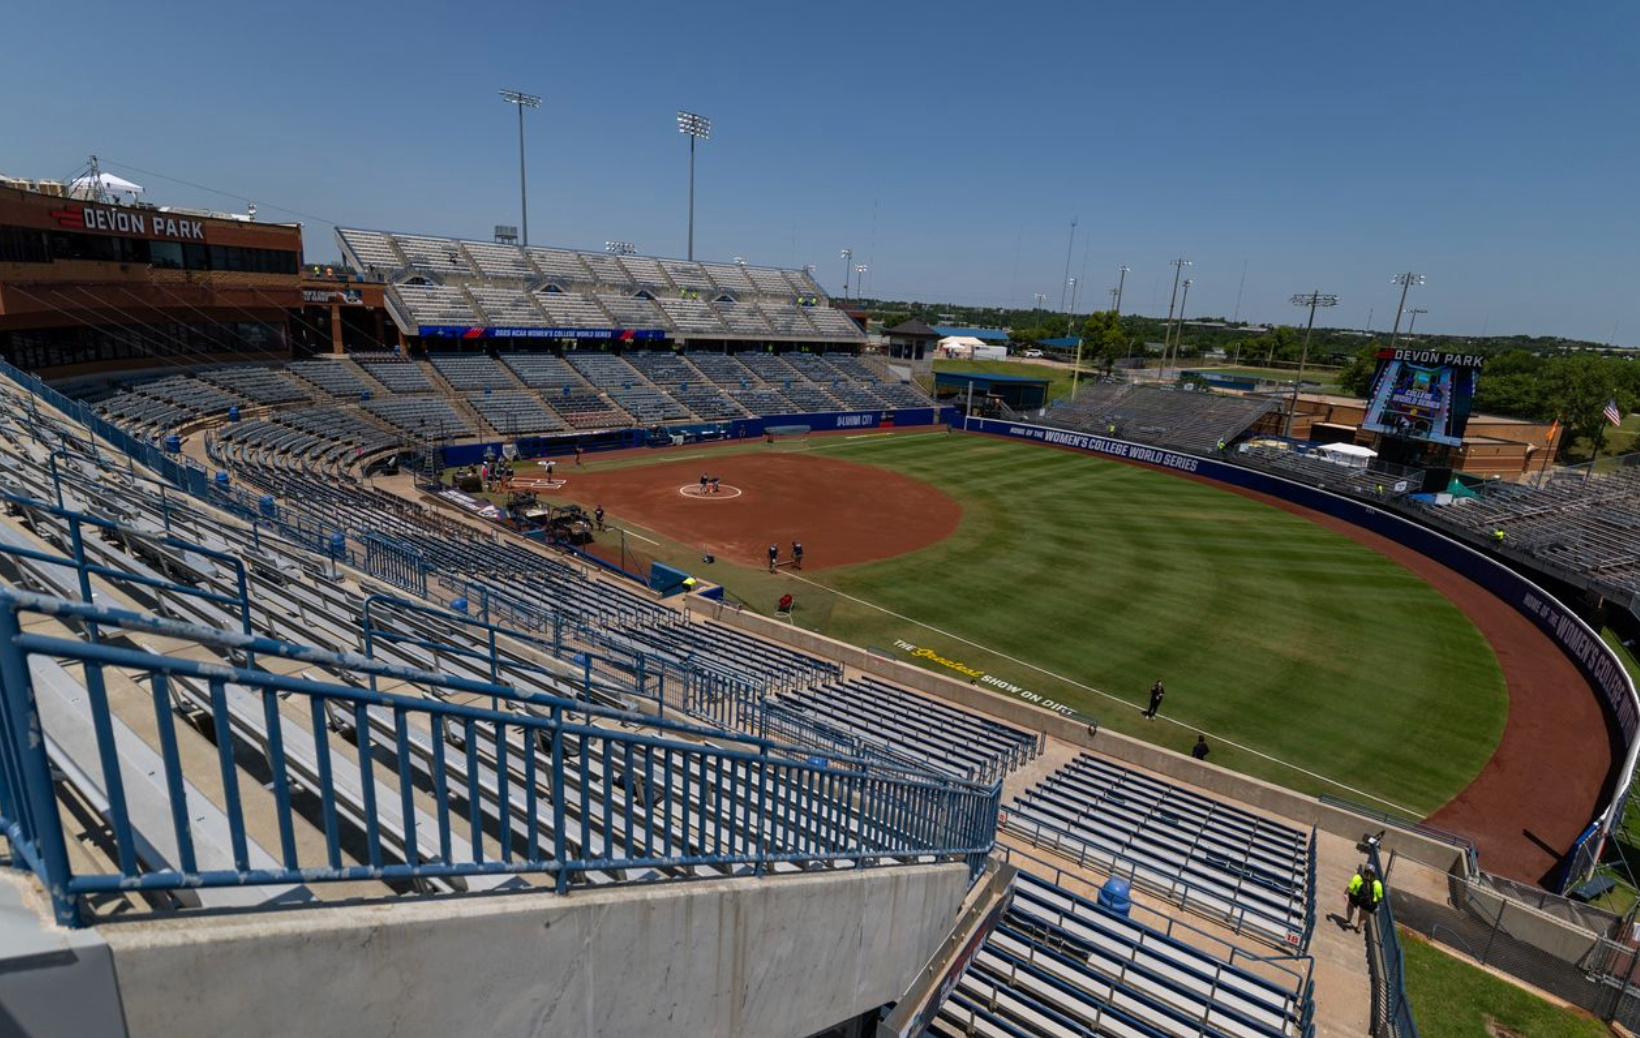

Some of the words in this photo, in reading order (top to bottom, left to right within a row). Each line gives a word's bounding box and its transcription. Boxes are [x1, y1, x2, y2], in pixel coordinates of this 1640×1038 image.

[83, 208, 145, 234] DEVON
[152, 217, 204, 239] PARK
[1394, 350, 1440, 363] DEVON
[1443, 354, 1484, 367] PARK
[1034, 430, 1045, 438] THE
[1045, 430, 1089, 448] WOMEN'S
[1088, 439, 1129, 456] COLLEGE
[1129, 445, 1162, 464] WORLD
[1163, 454, 1199, 472] SERIES
[893, 639, 917, 651] THE
[911, 647, 985, 678] Greatest
[980, 674, 1023, 693] SHOW
[1020, 690, 1043, 703] ON
[1556, 615, 1600, 670] WOMEN'S
[1594, 654, 1625, 712] COLLEGE
[1287, 934, 1298, 943] 18
